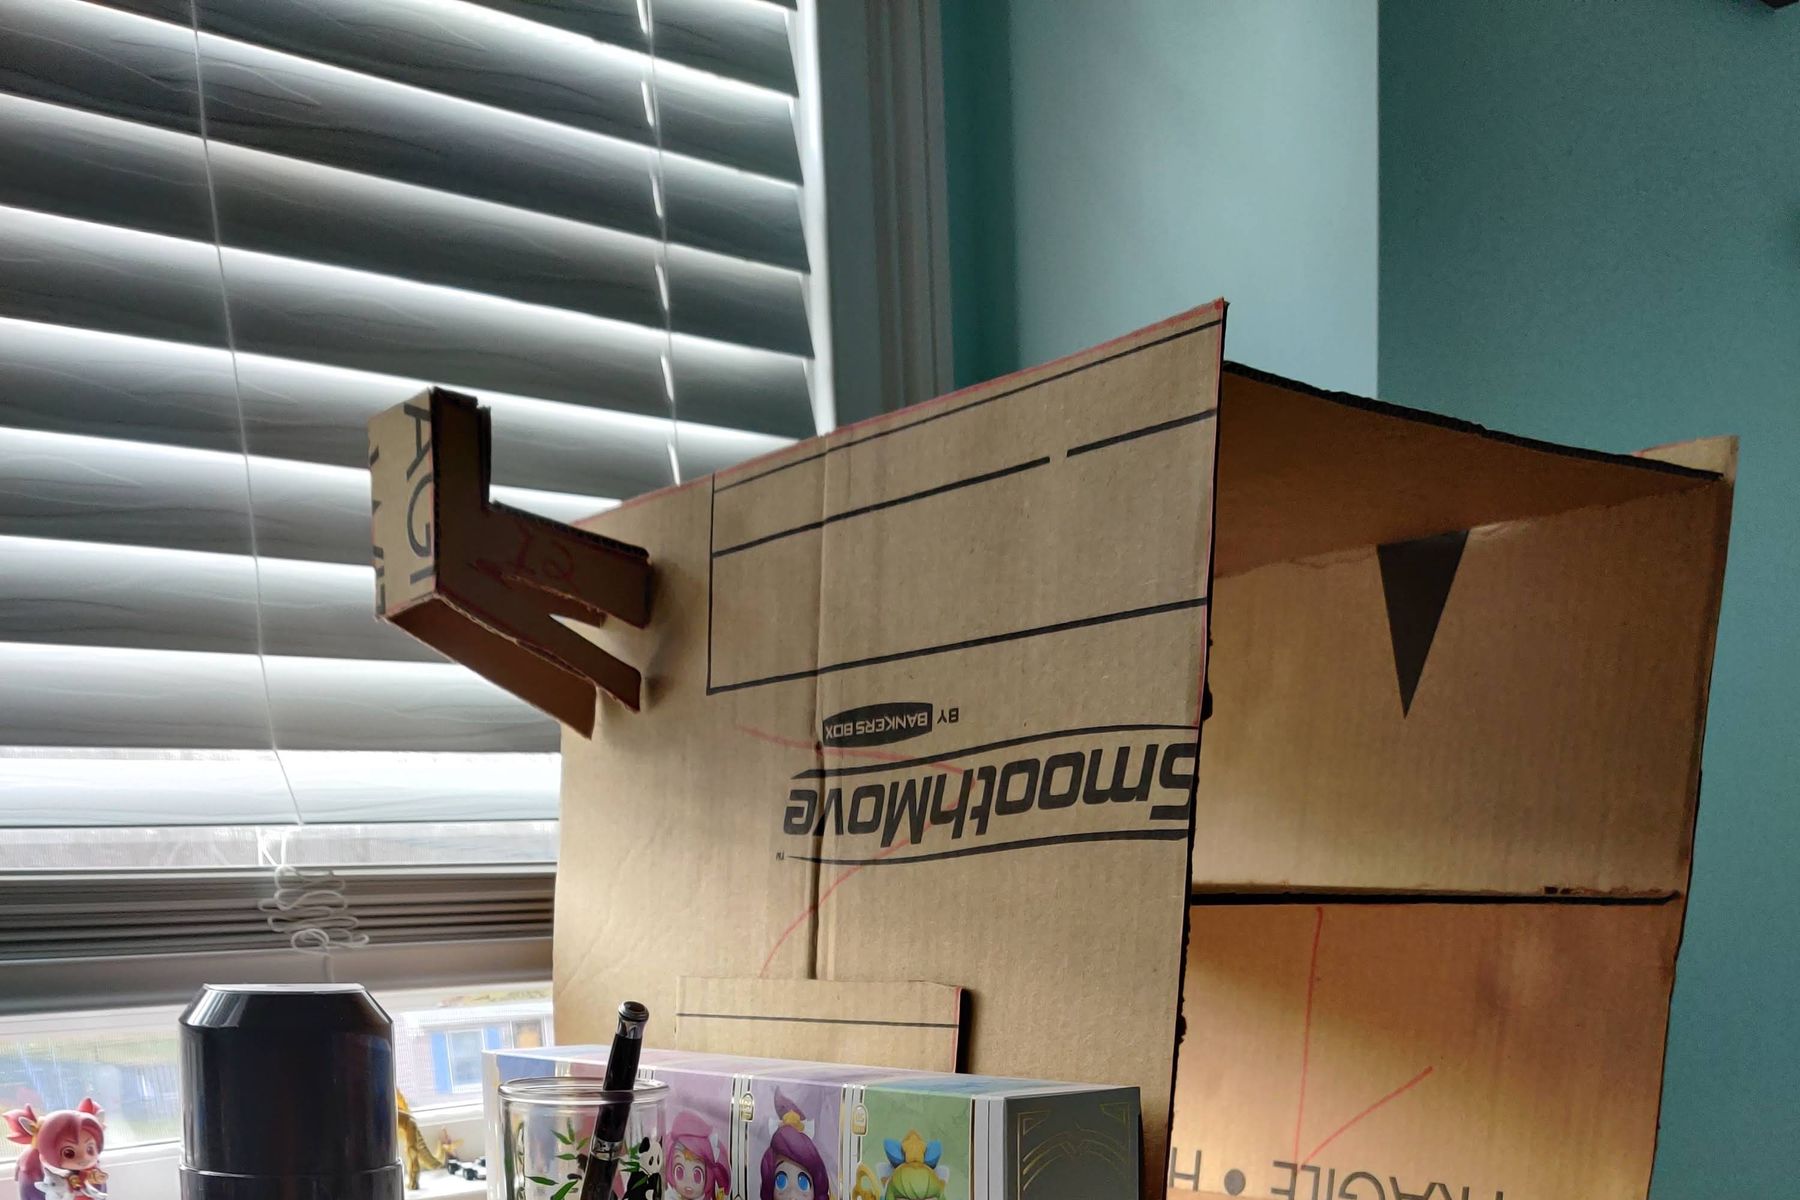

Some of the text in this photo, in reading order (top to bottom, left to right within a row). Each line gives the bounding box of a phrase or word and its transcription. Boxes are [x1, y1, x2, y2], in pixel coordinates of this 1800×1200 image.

[825, 707, 960, 739] BY BANKERS BOX
[782, 742, 1199, 849] SmoothMove
